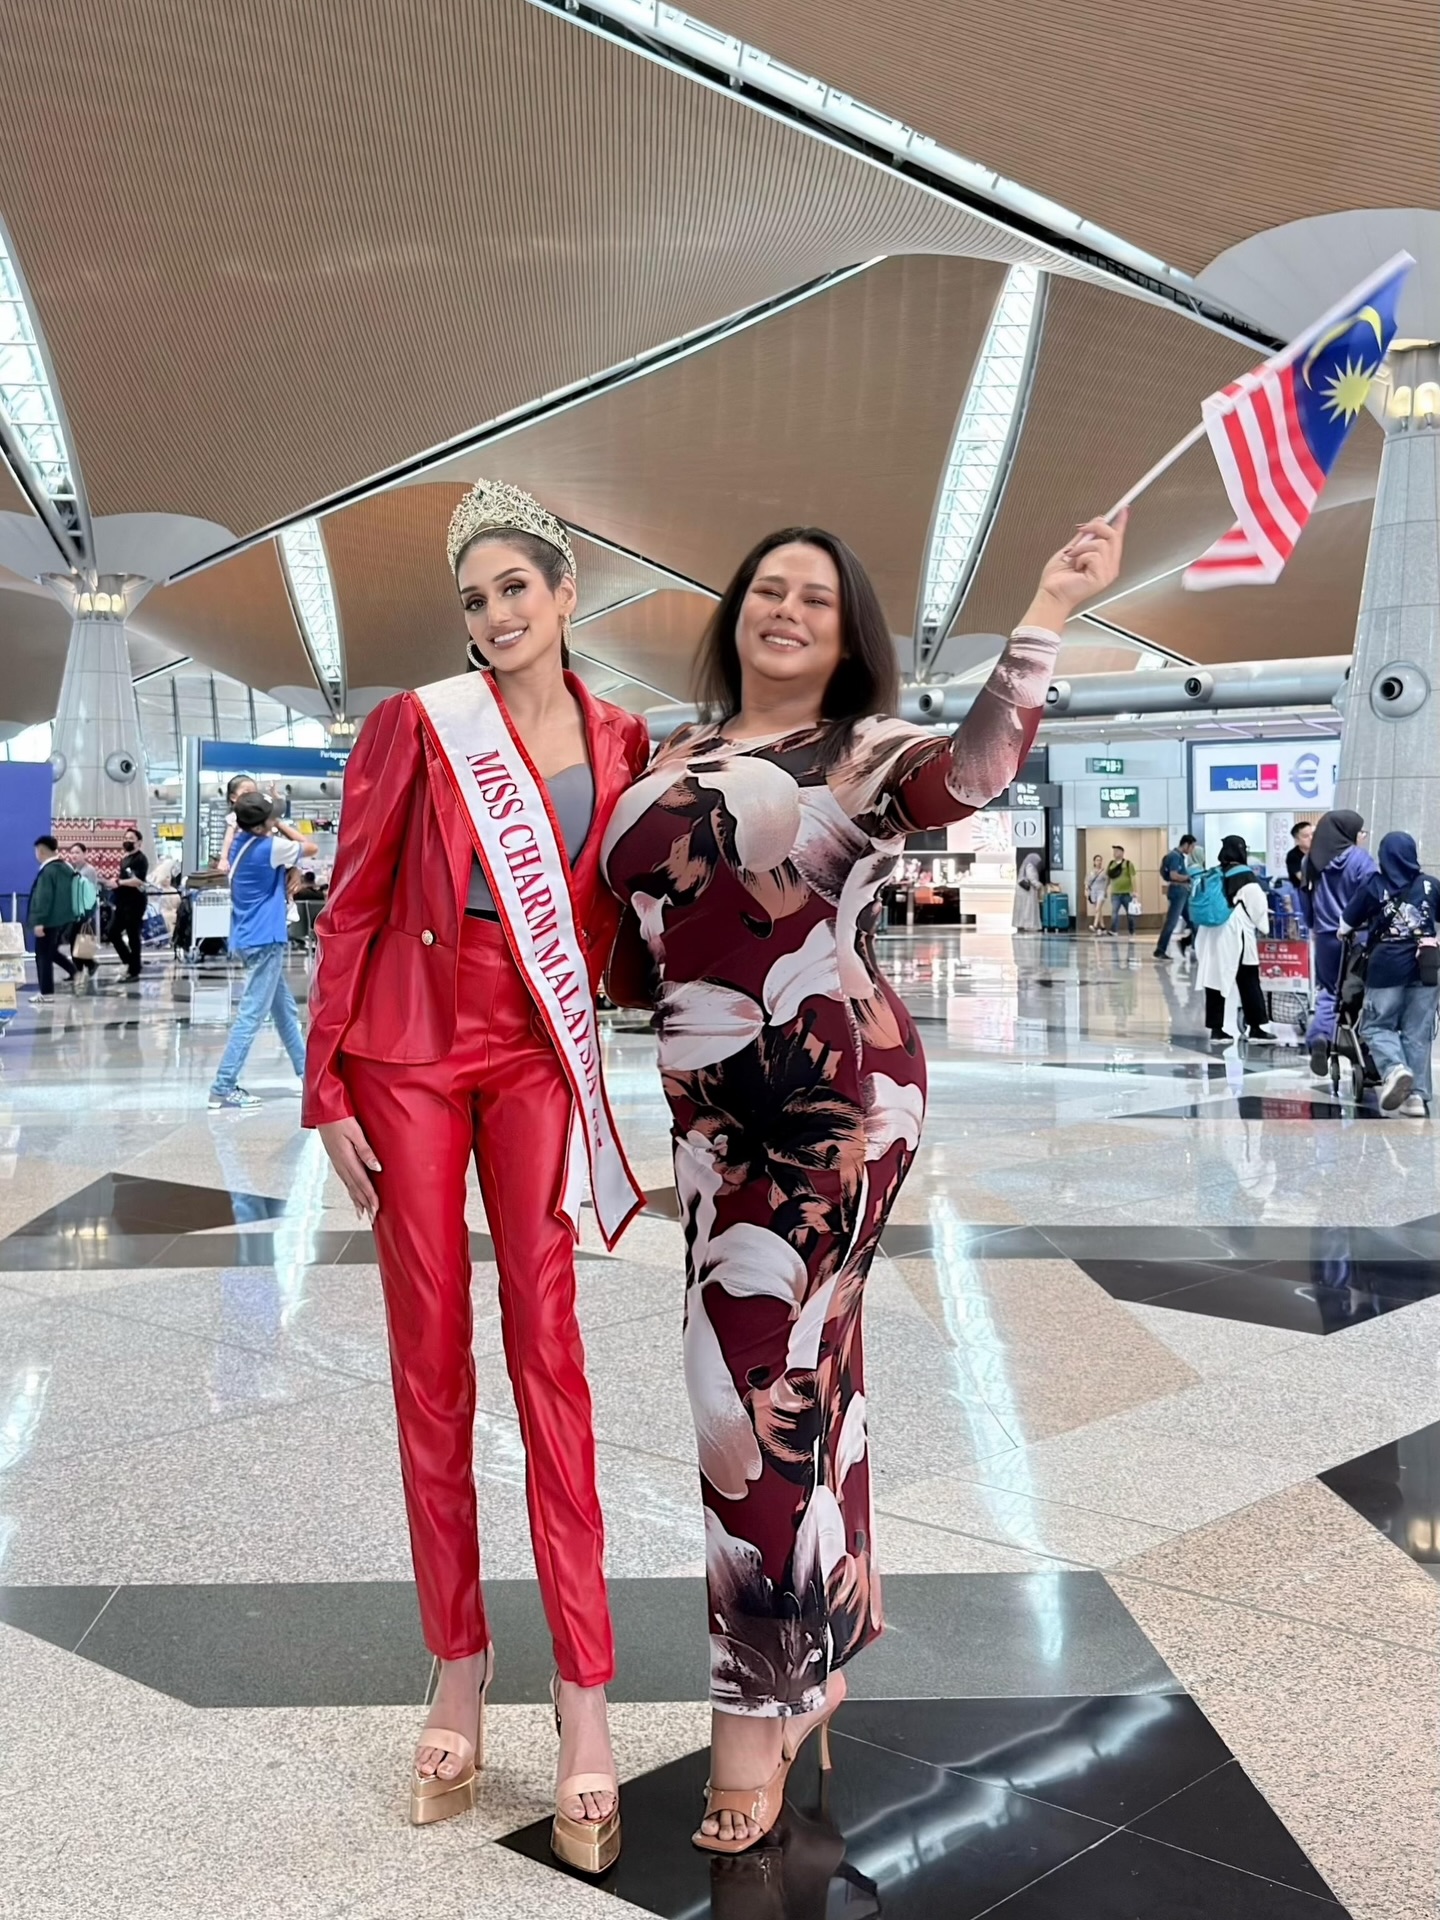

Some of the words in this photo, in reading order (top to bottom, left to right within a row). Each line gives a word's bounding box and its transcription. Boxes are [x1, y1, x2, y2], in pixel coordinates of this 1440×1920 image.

[465, 748, 525, 820] MISS
[499, 823, 558, 944] CHARM
[534, 935, 599, 1098] MALAYSIA
